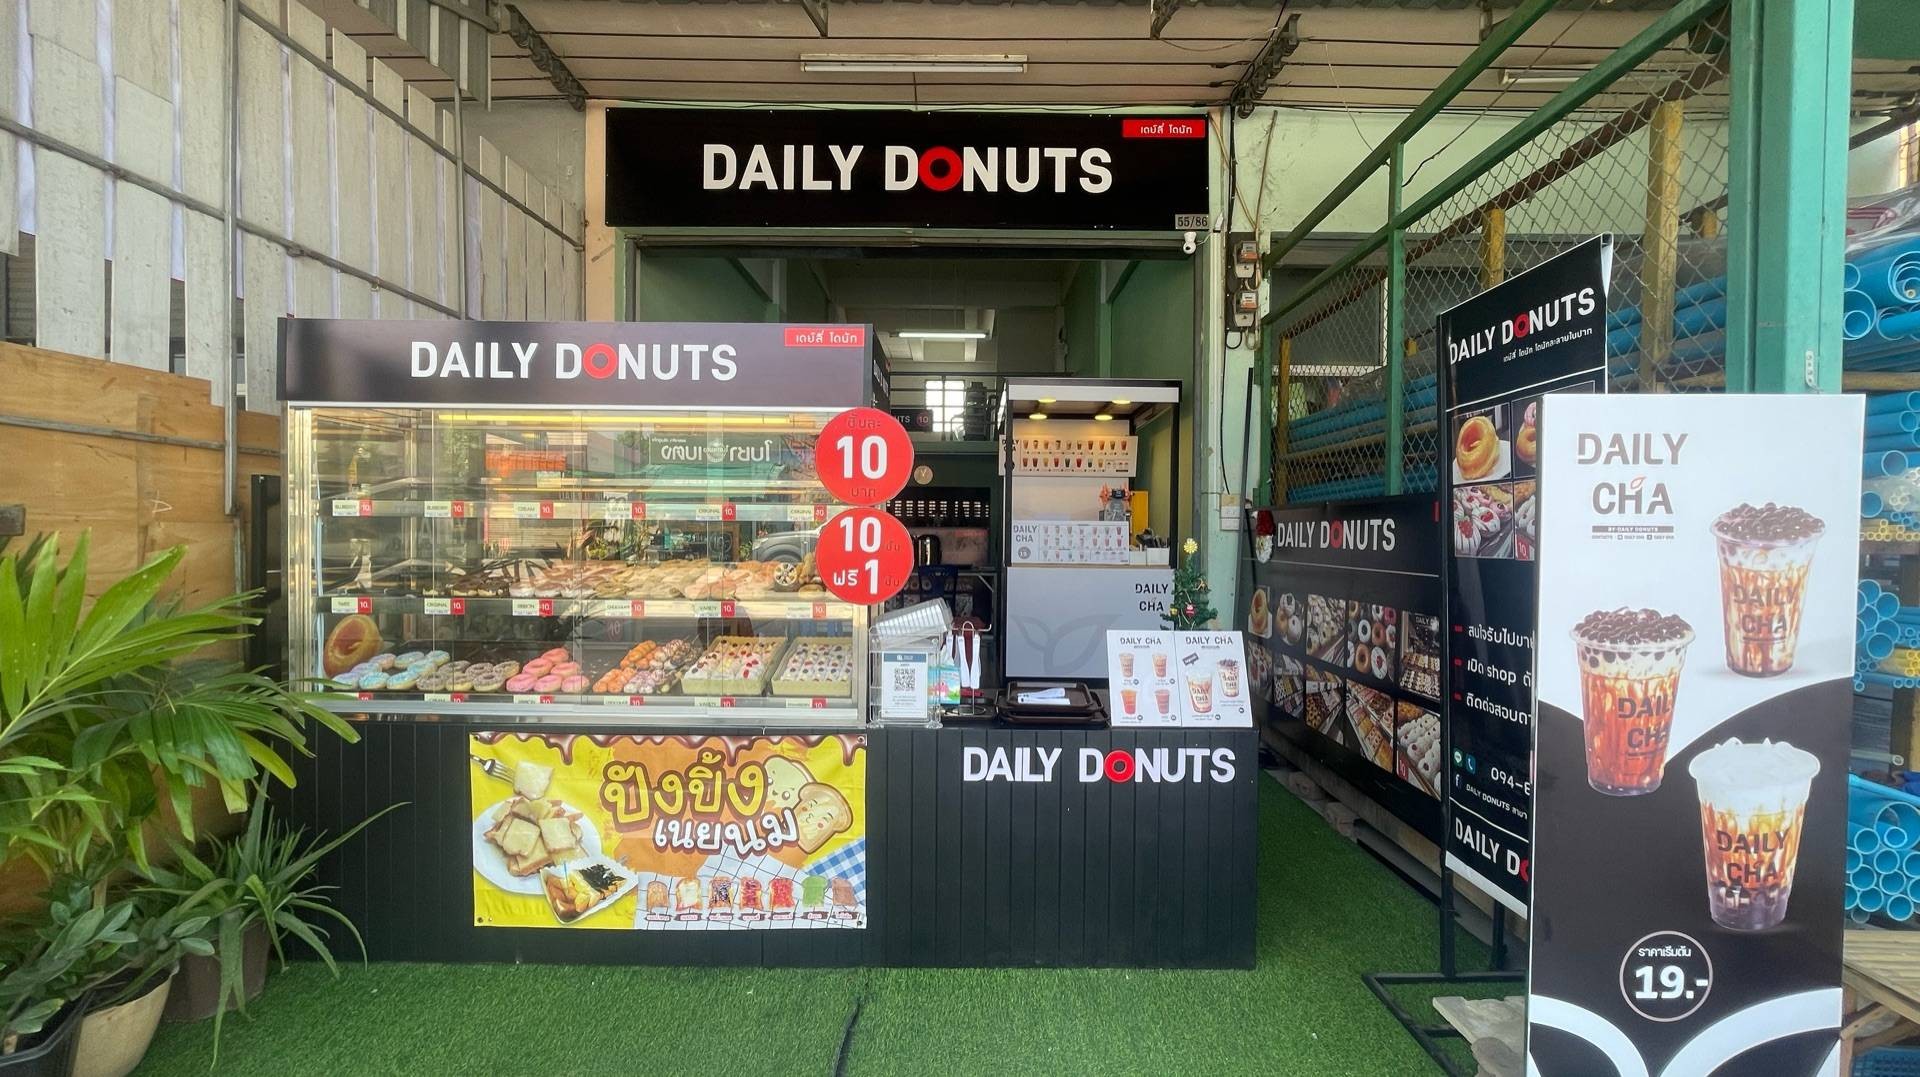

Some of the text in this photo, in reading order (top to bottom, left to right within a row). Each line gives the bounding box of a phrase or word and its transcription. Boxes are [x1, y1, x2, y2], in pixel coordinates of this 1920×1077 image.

[1168, 124, 1192, 134] โดนัท
[703, 143, 1113, 194] DAILY DONUTS
[1177, 216, 1208, 228] 55/86
[828, 331, 857, 344] โดนัท
[1449, 287, 1596, 365] DAILY DONUTS
[410, 341, 738, 382] DAILY DONUTS
[837, 435, 888, 480] 10
[1577, 432, 1689, 465] DAILY
[852, 487, 876, 498] บาท
[1592, 482, 1673, 515] CHA
[840, 516, 881, 553] 10
[1013, 525, 1038, 534] DAILY
[1015, 534, 1034, 543] CHA
[1278, 518, 1396, 552] DAILY DONUTS
[833, 569, 859, 587] ฟรี
[865, 559, 879, 595] 1
[1135, 583, 1169, 594] DAILY
[1139, 601, 1164, 612] CHA
[1733, 584, 1797, 608] DAILY
[1742, 613, 1788, 634] CHA
[1120, 637, 1162, 645] DAILY CHA
[1185, 636, 1233, 645] DAILY CHA
[1467, 658, 1484, 674] เปิด
[1486, 665, 1517, 686] shop
[1466, 692, 1532, 726] ติดต่อสอบถ
[963, 747, 1236, 784] DAILY DONUTS
[604, 751, 764, 824] ปังปิ้ง
[1466, 783, 1481, 796] DAILY
[1482, 792, 1510, 811] DONUTS
[655, 807, 798, 856] เนยนม
[1455, 817, 1500, 864] DAILY
[1717, 827, 1792, 854] DAILY
[1727, 862, 1779, 884] CHA
[1638, 945, 1692, 957] ราคาเริ่มต้น
[1635, 965, 1708, 999] 19.-
